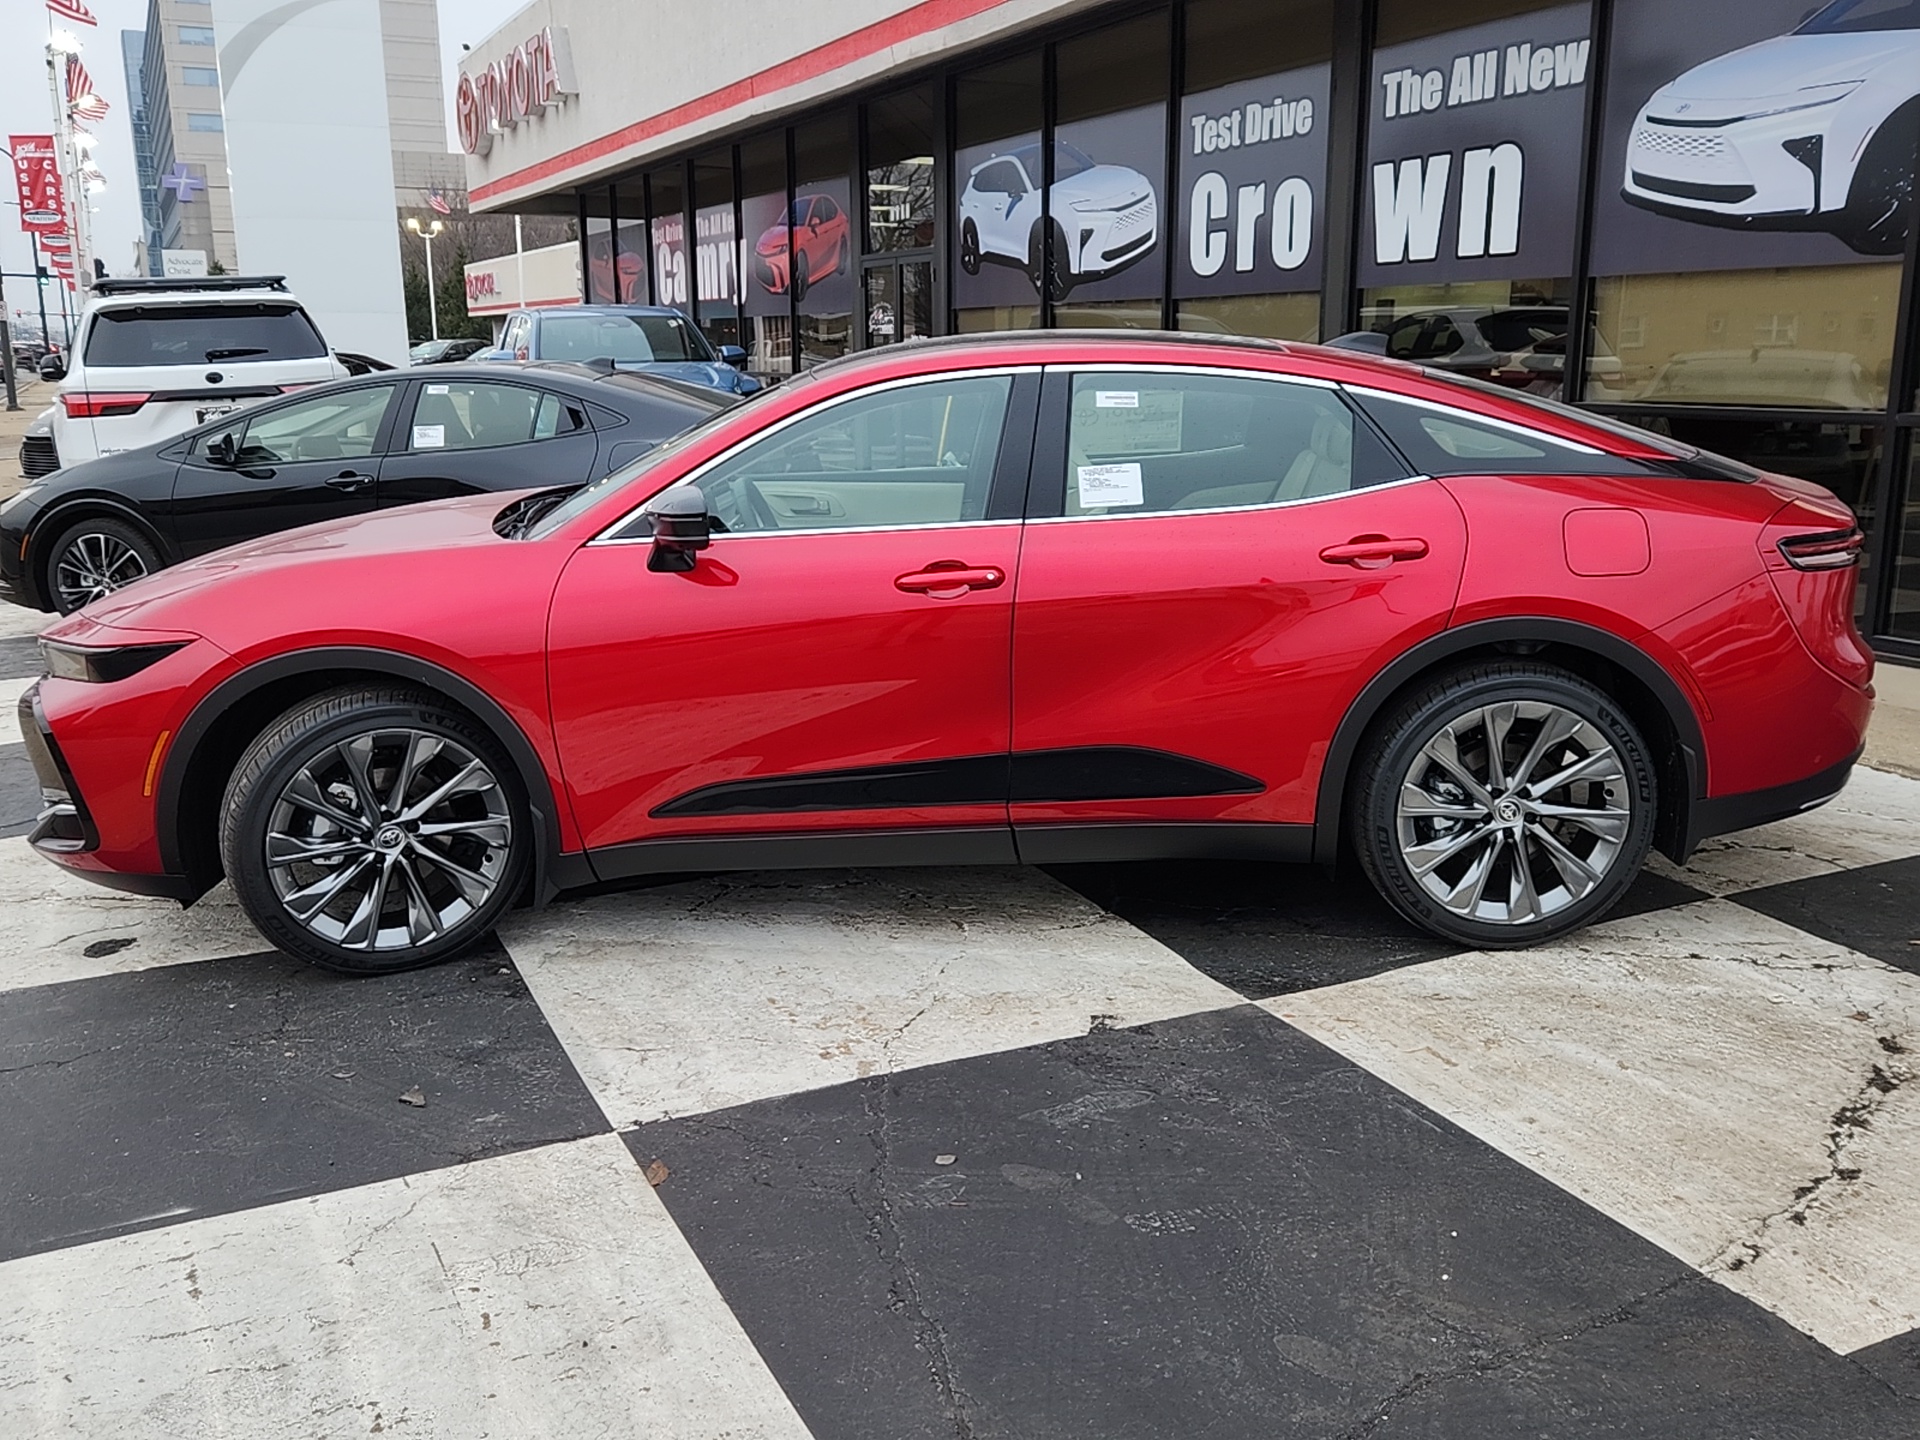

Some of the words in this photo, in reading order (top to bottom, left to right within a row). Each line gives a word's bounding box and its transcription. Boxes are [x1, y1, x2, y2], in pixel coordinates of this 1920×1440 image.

[475, 26, 560, 136] TOYOTA
[1383, 68, 1443, 118] The
[1448, 49, 1498, 106] All
[1504, 39, 1590, 96] New
[1191, 109, 1241, 154] Test
[1244, 97, 1313, 144] Drive
[17, 160, 34, 209] USED
[42, 160, 57, 209] CARS
[1612, 723, 1651, 799] MICHELIN
